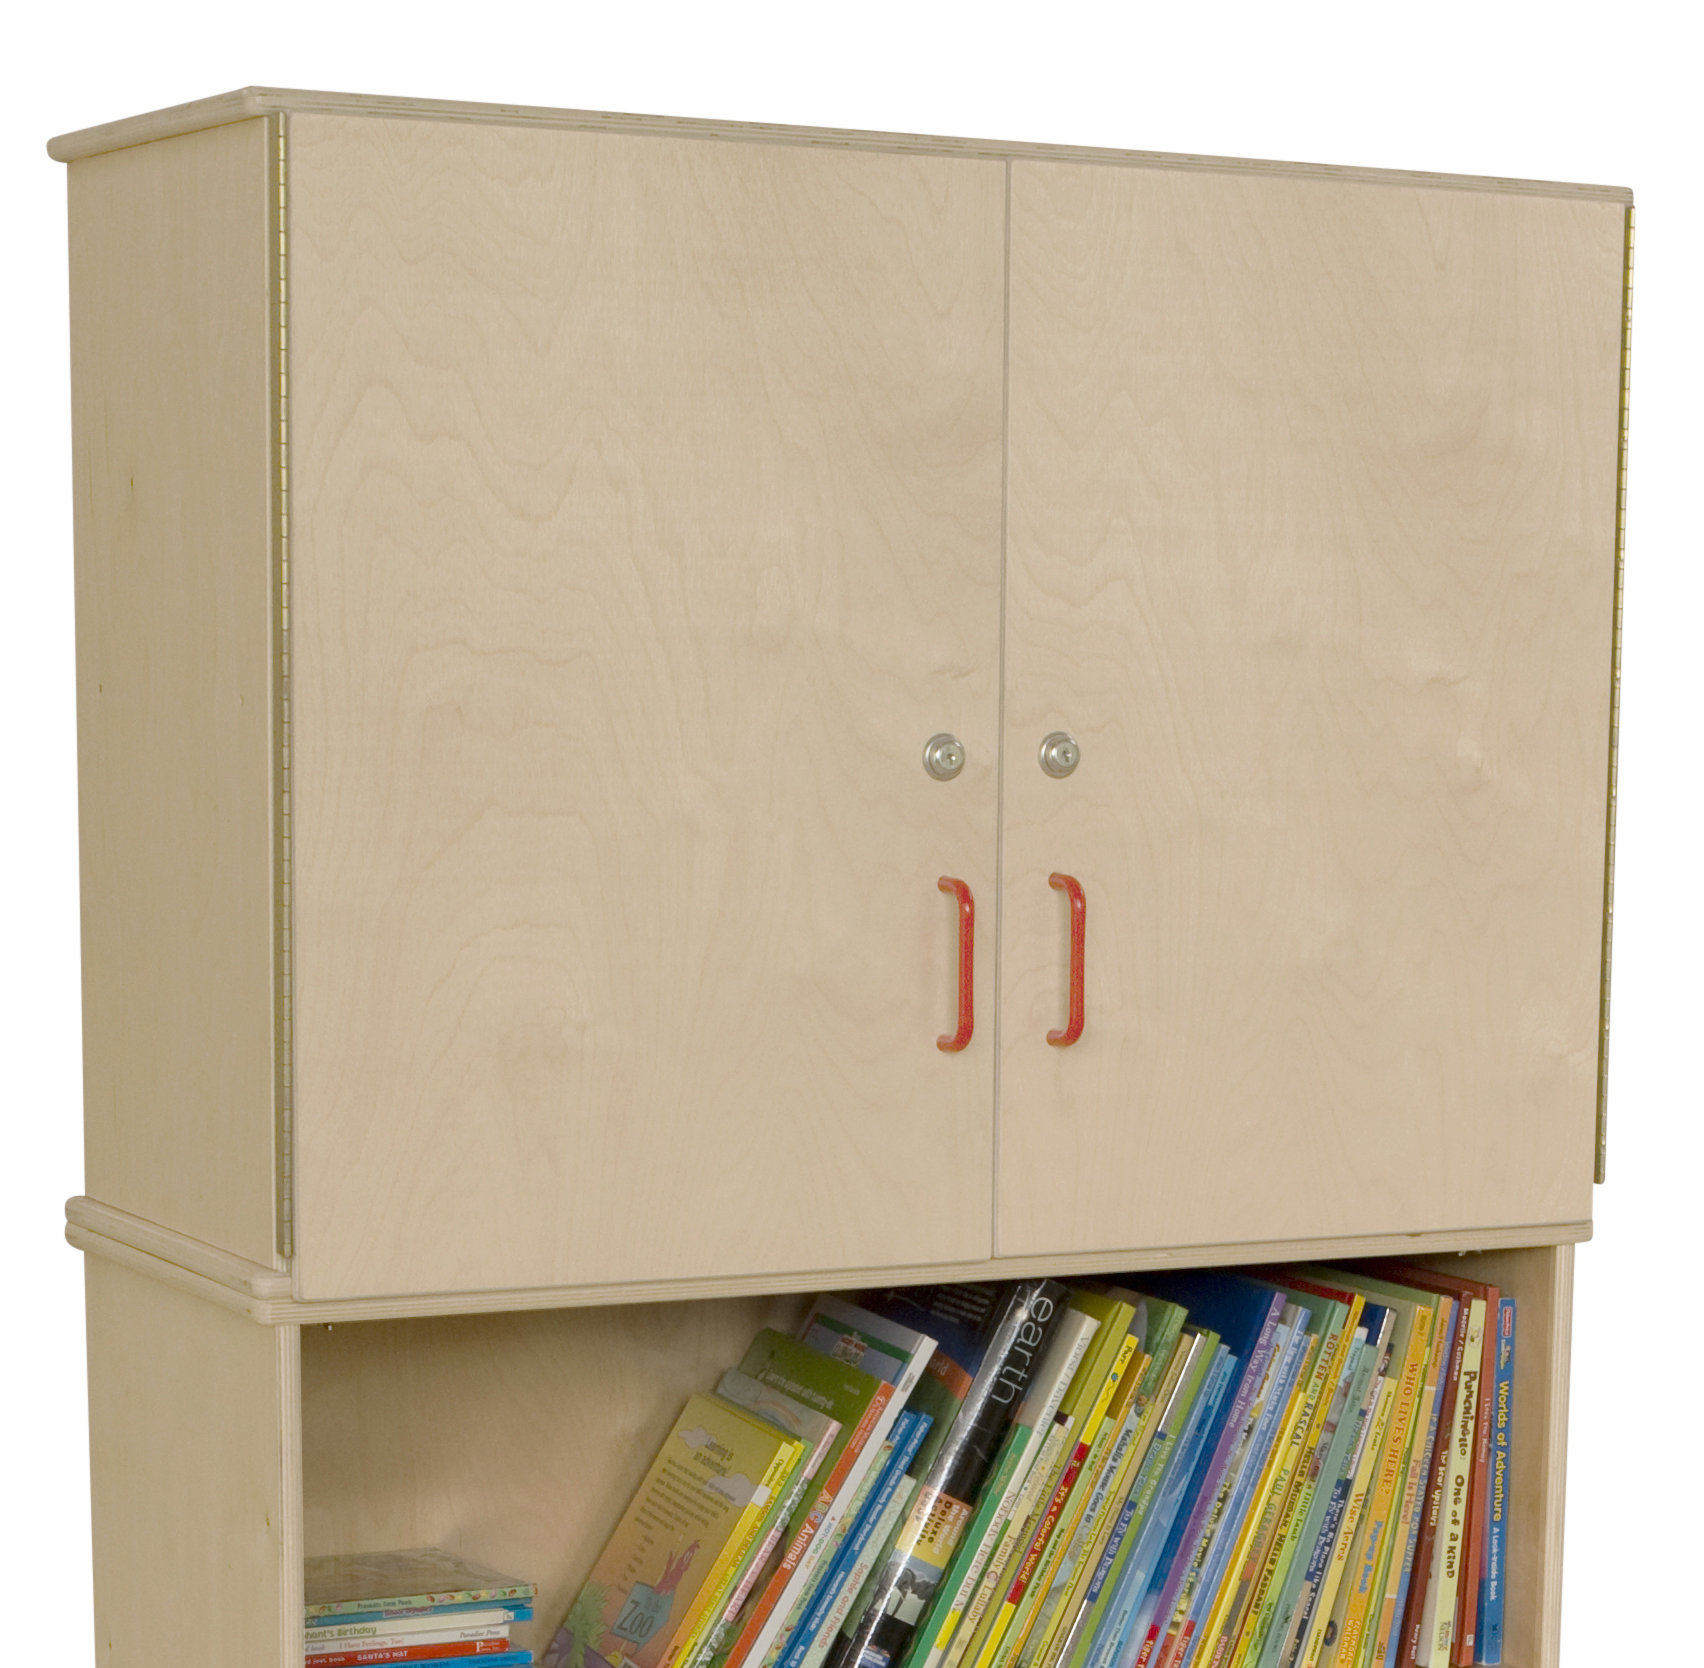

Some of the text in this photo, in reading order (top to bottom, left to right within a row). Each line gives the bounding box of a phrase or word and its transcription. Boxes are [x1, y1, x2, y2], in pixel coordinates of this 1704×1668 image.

[988, 1293, 1062, 1407] earth
[1066, 1334, 1089, 1371] Viorst
[1118, 1345, 1132, 1365] Parr
[1277, 1329, 1303, 1384] The with
[1315, 1332, 1338, 1380] ROTTEN
[1451, 1346, 1463, 1381] Cushman
[1228, 1306, 1280, 1429] A Long Way from Home
[1308, 1381, 1320, 1400] AND
[1289, 1401, 1314, 1447] RASCAL
[1379, 1361, 1419, 1495] WHO LIVES HERE?
[1160, 1441, 1173, 1459] Love
[1297, 1445, 1314, 1478] HELLO
[1492, 1379, 1510, 1521] Worlds of Adventure
[1048, 1461, 1061, 1480] The
[1098, 1463, 1117, 1491] Mouse
[1272, 1467, 1289, 1496] PAUL
[1054, 1484, 1068, 1504] It's
[1088, 1491, 1104, 1513] Goes
[1136, 1478, 1157, 1515] Grandpa
[1331, 1485, 1341, 1501] To
[1400, 1458, 1420, 1524] Fall Is Here!
[1427, 1449, 1448, 1526] The Bear Upstairs
[808, 1489, 835, 1524] ABC
[925, 1499, 953, 1544] Deluxe
[986, 1489, 1016, 1538] Nobody
[1084, 1513, 1094, 1524] to
[1123, 1509, 1133, 1521] To
[1329, 1498, 1344, 1528] There's
[931, 1503, 961, 1554] the World
[945, 1508, 969, 1545] Around
[1032, 1514, 1055, 1551] Colorful
[1320, 1516, 1332, 1536] with
[1325, 1530, 1334, 1542] No
[1335, 1491, 1364, 1562] Wise Acres
[781, 1522, 816, 1572] Animals
[970, 1542, 991, 1574] Here
[1107, 1536, 1121, 1557] with
[1192, 1537, 1209, 1569] Movie
[1268, 1533, 1285, 1567] HELLO
[1316, 1545, 1330, 1568] Place
[958, 1575, 975, 1598] but
[966, 1534, 1016, 1625] Family Lullaby
[1091, 1555, 1113, 1594] Dragons
[1358, 1563, 1373, 1594] Book
[1489, 1581, 1497, 1600] Book
[617, 1600, 654, 1639] Zoo
[817, 1562, 868, 1650] Sophie and Friends
[337, 1625, 376, 1636] Birthday
[1174, 1633, 1190, 1657] tiger
[1338, 1618, 1354, 1659] WALDMAN
[1410, 1623, 1420, 1644] Henry
[356, 1652, 390, 1660] SANTA'S
[1138, 1637, 1155, 1662] tiger
